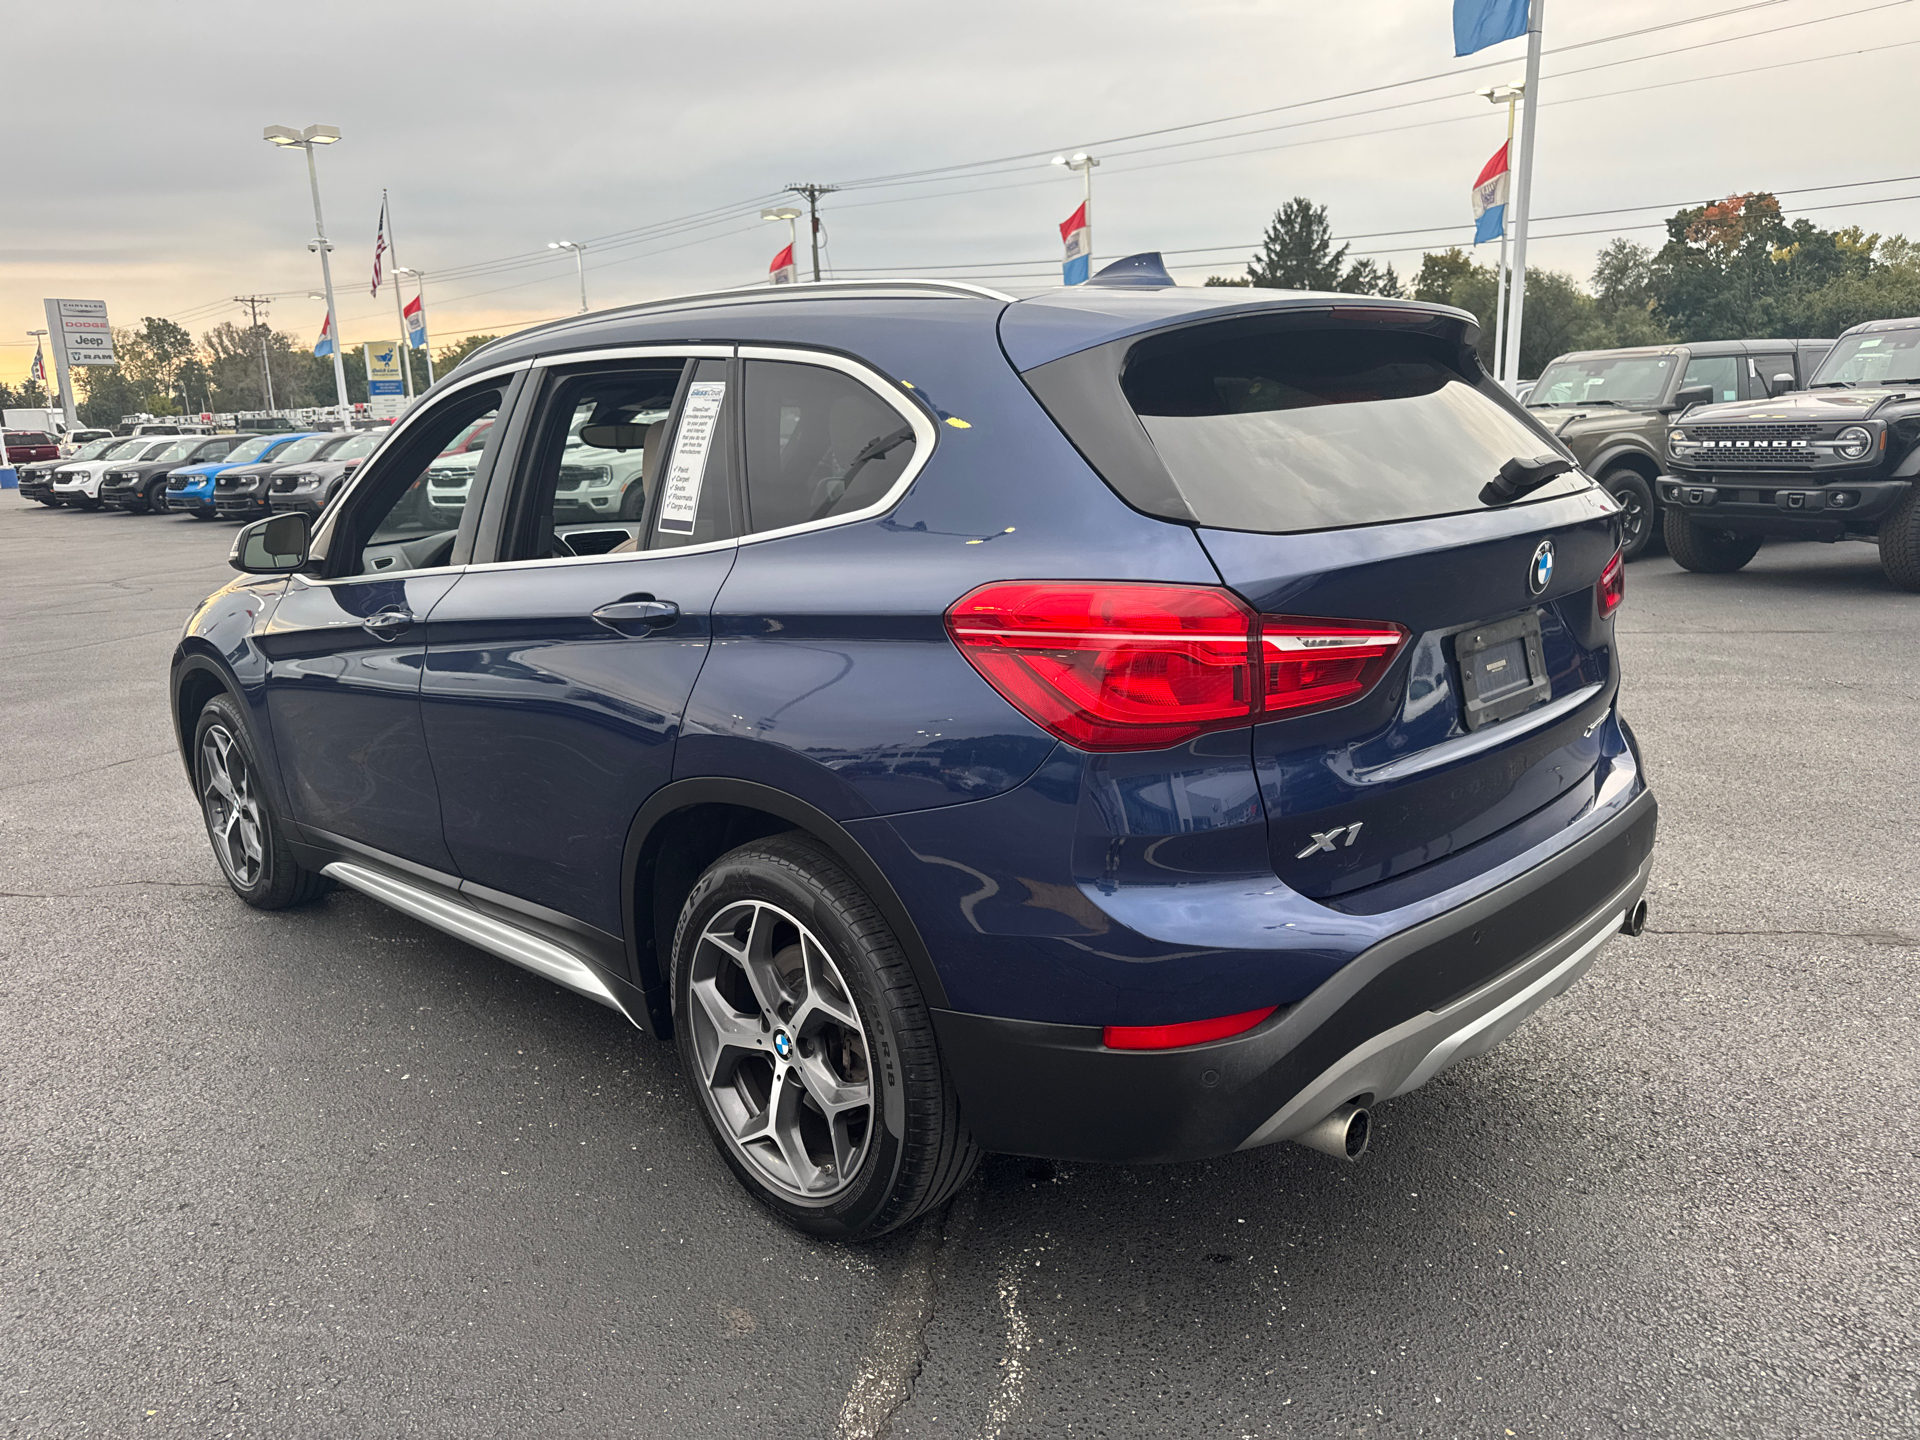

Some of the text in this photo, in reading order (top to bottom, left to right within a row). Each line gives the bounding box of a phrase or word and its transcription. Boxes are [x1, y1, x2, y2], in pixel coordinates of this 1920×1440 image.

[75, 335, 103, 346] Jeep
[671, 502, 683, 511] Cargo
[1295, 821, 1363, 859] X1
[881, 1041, 895, 1087] R18
